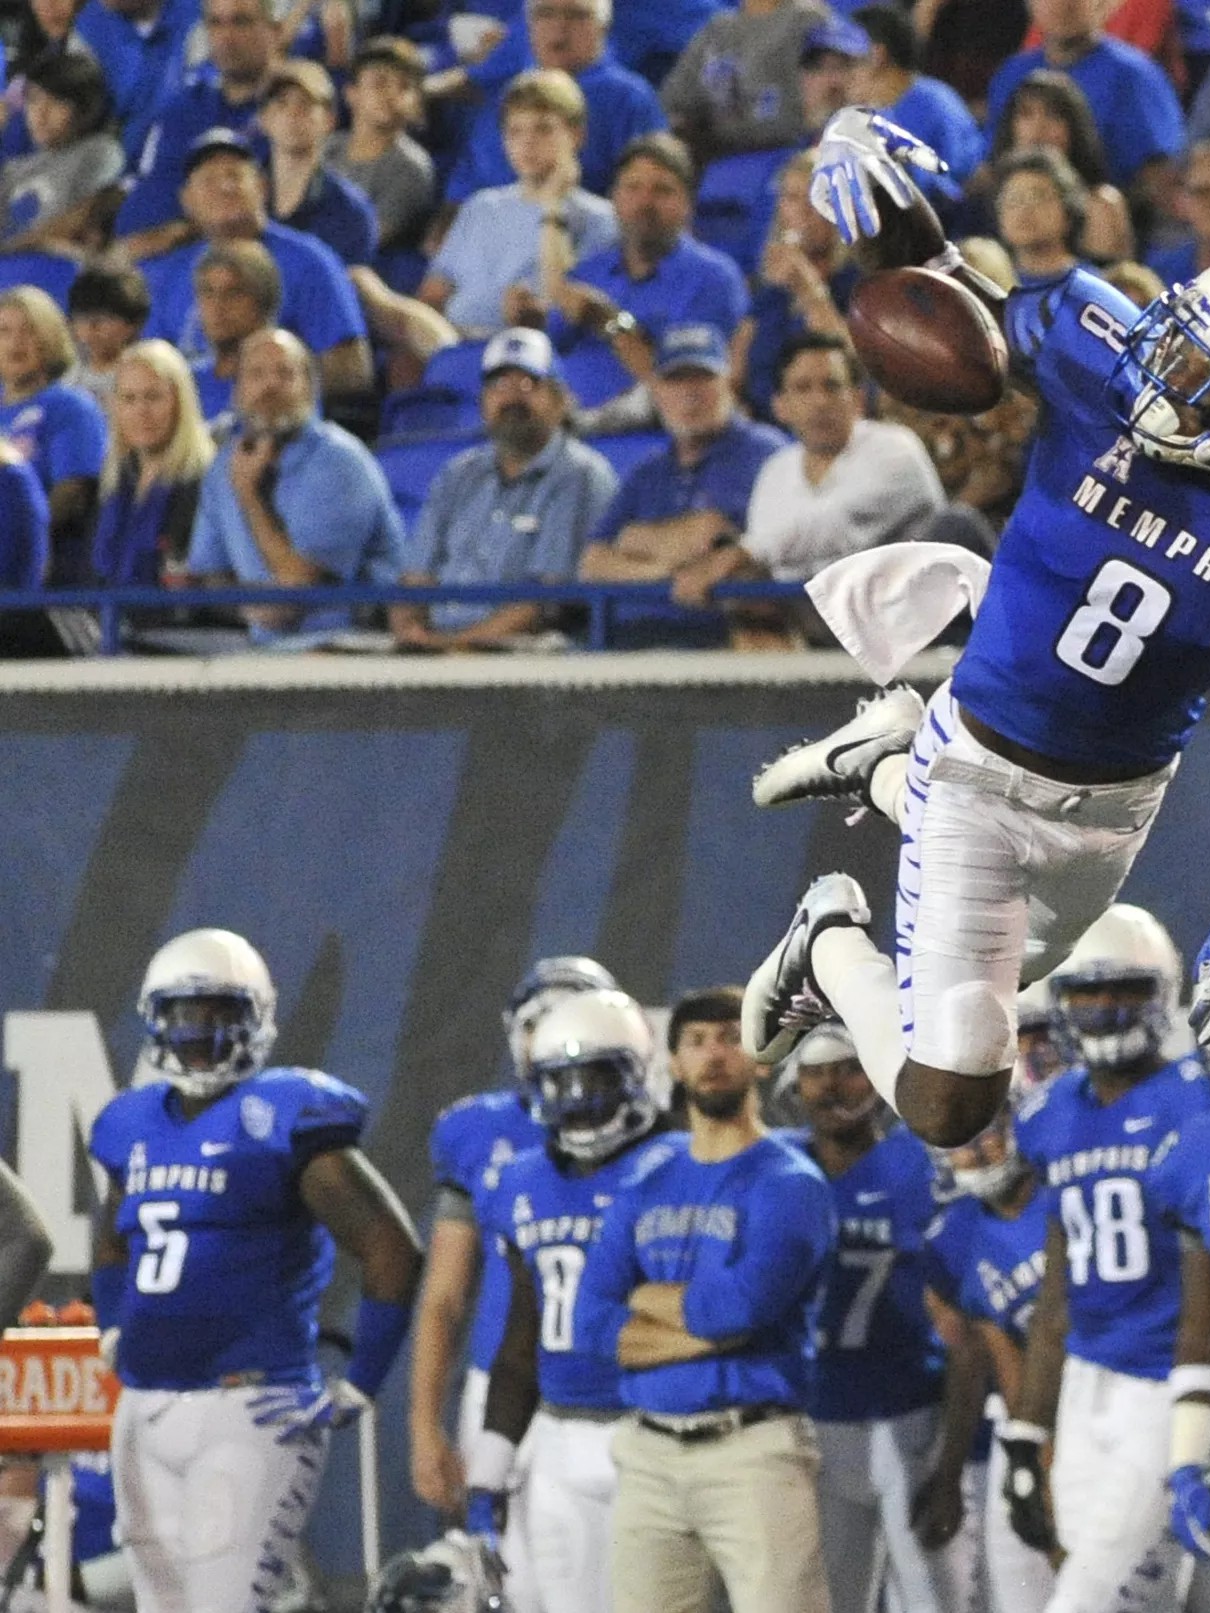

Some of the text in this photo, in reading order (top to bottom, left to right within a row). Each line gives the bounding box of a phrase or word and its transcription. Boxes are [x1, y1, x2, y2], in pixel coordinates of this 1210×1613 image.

[1056, 559, 1172, 686] 8
[136, 1201, 189, 1294] 5
[1061, 1177, 1149, 1286] 48
